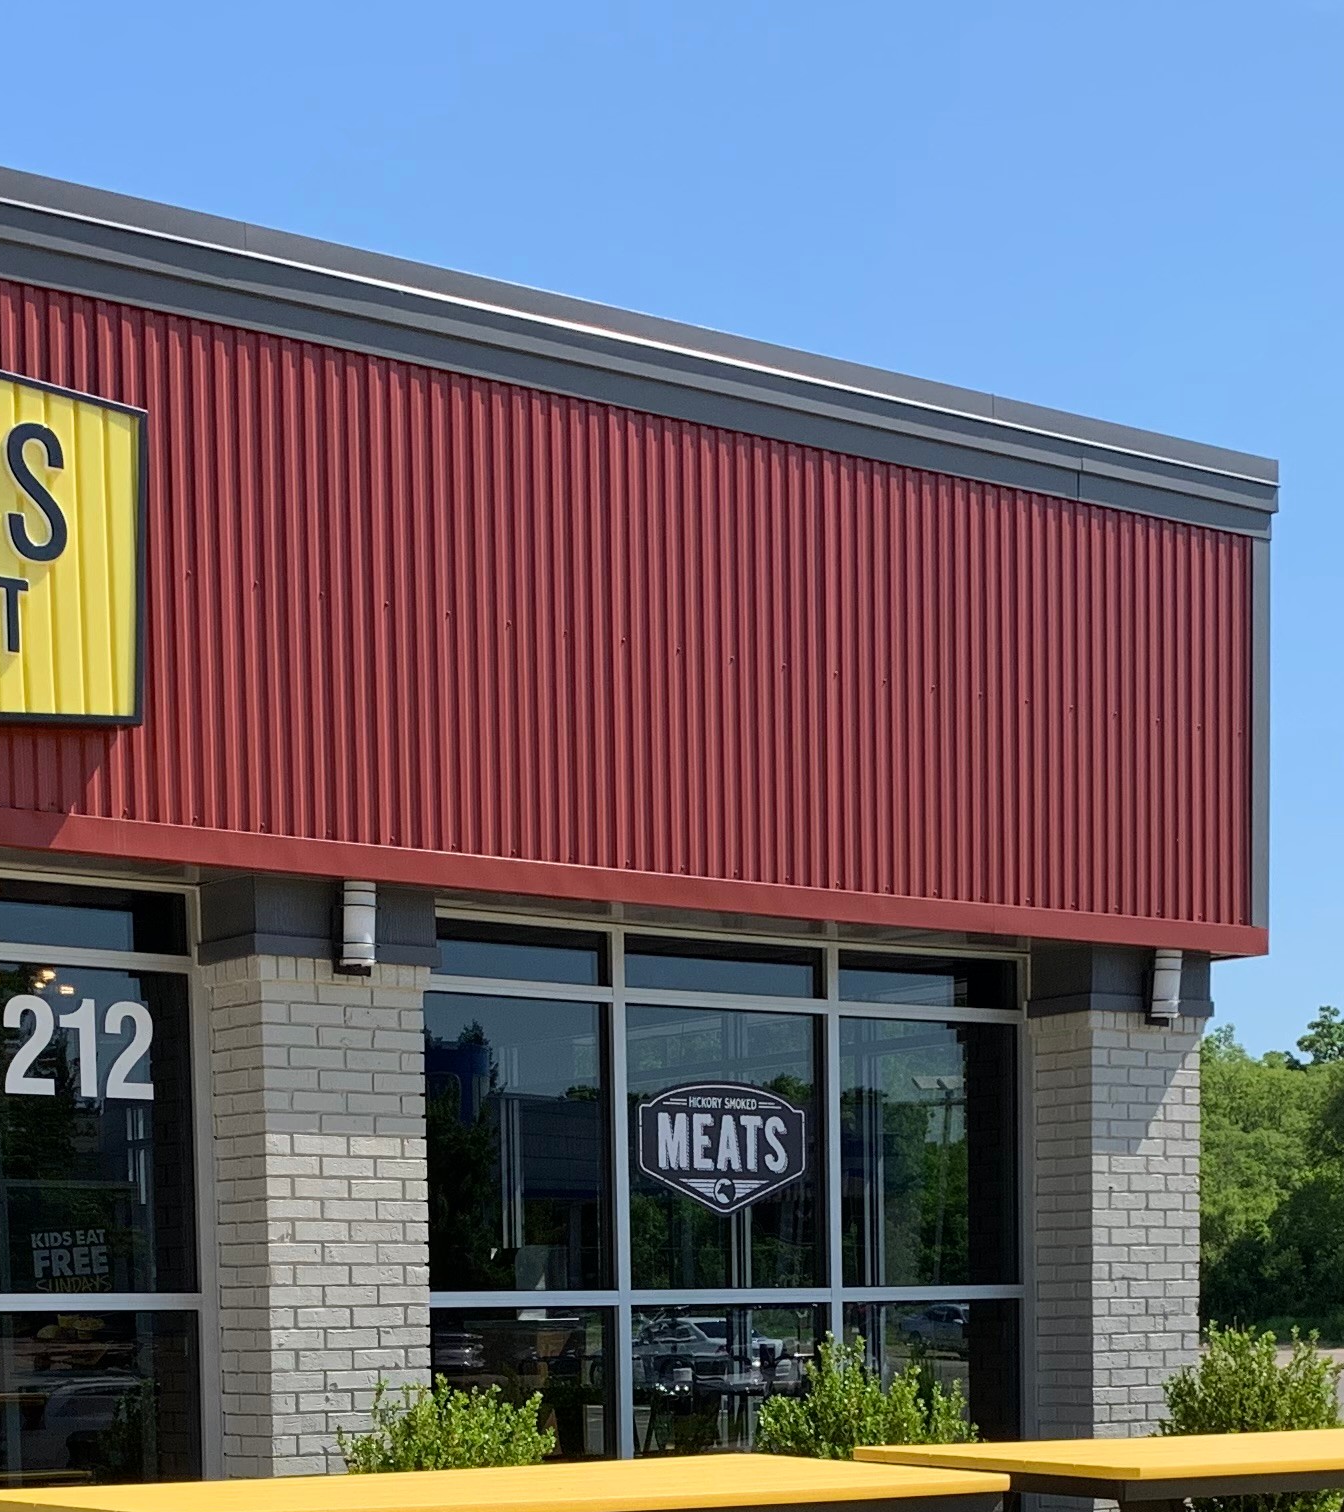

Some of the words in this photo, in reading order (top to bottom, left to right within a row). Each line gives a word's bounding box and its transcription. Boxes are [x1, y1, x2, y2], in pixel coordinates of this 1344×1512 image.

[688, 1096, 723, 1109] HICKORY
[724, 1098, 757, 1110] SMOKED
[657, 1111, 789, 1174] MEATS
[30, 1231, 73, 1249] KIDS
[75, 1229, 106, 1245] EAT
[33, 1245, 109, 1279] FREE
